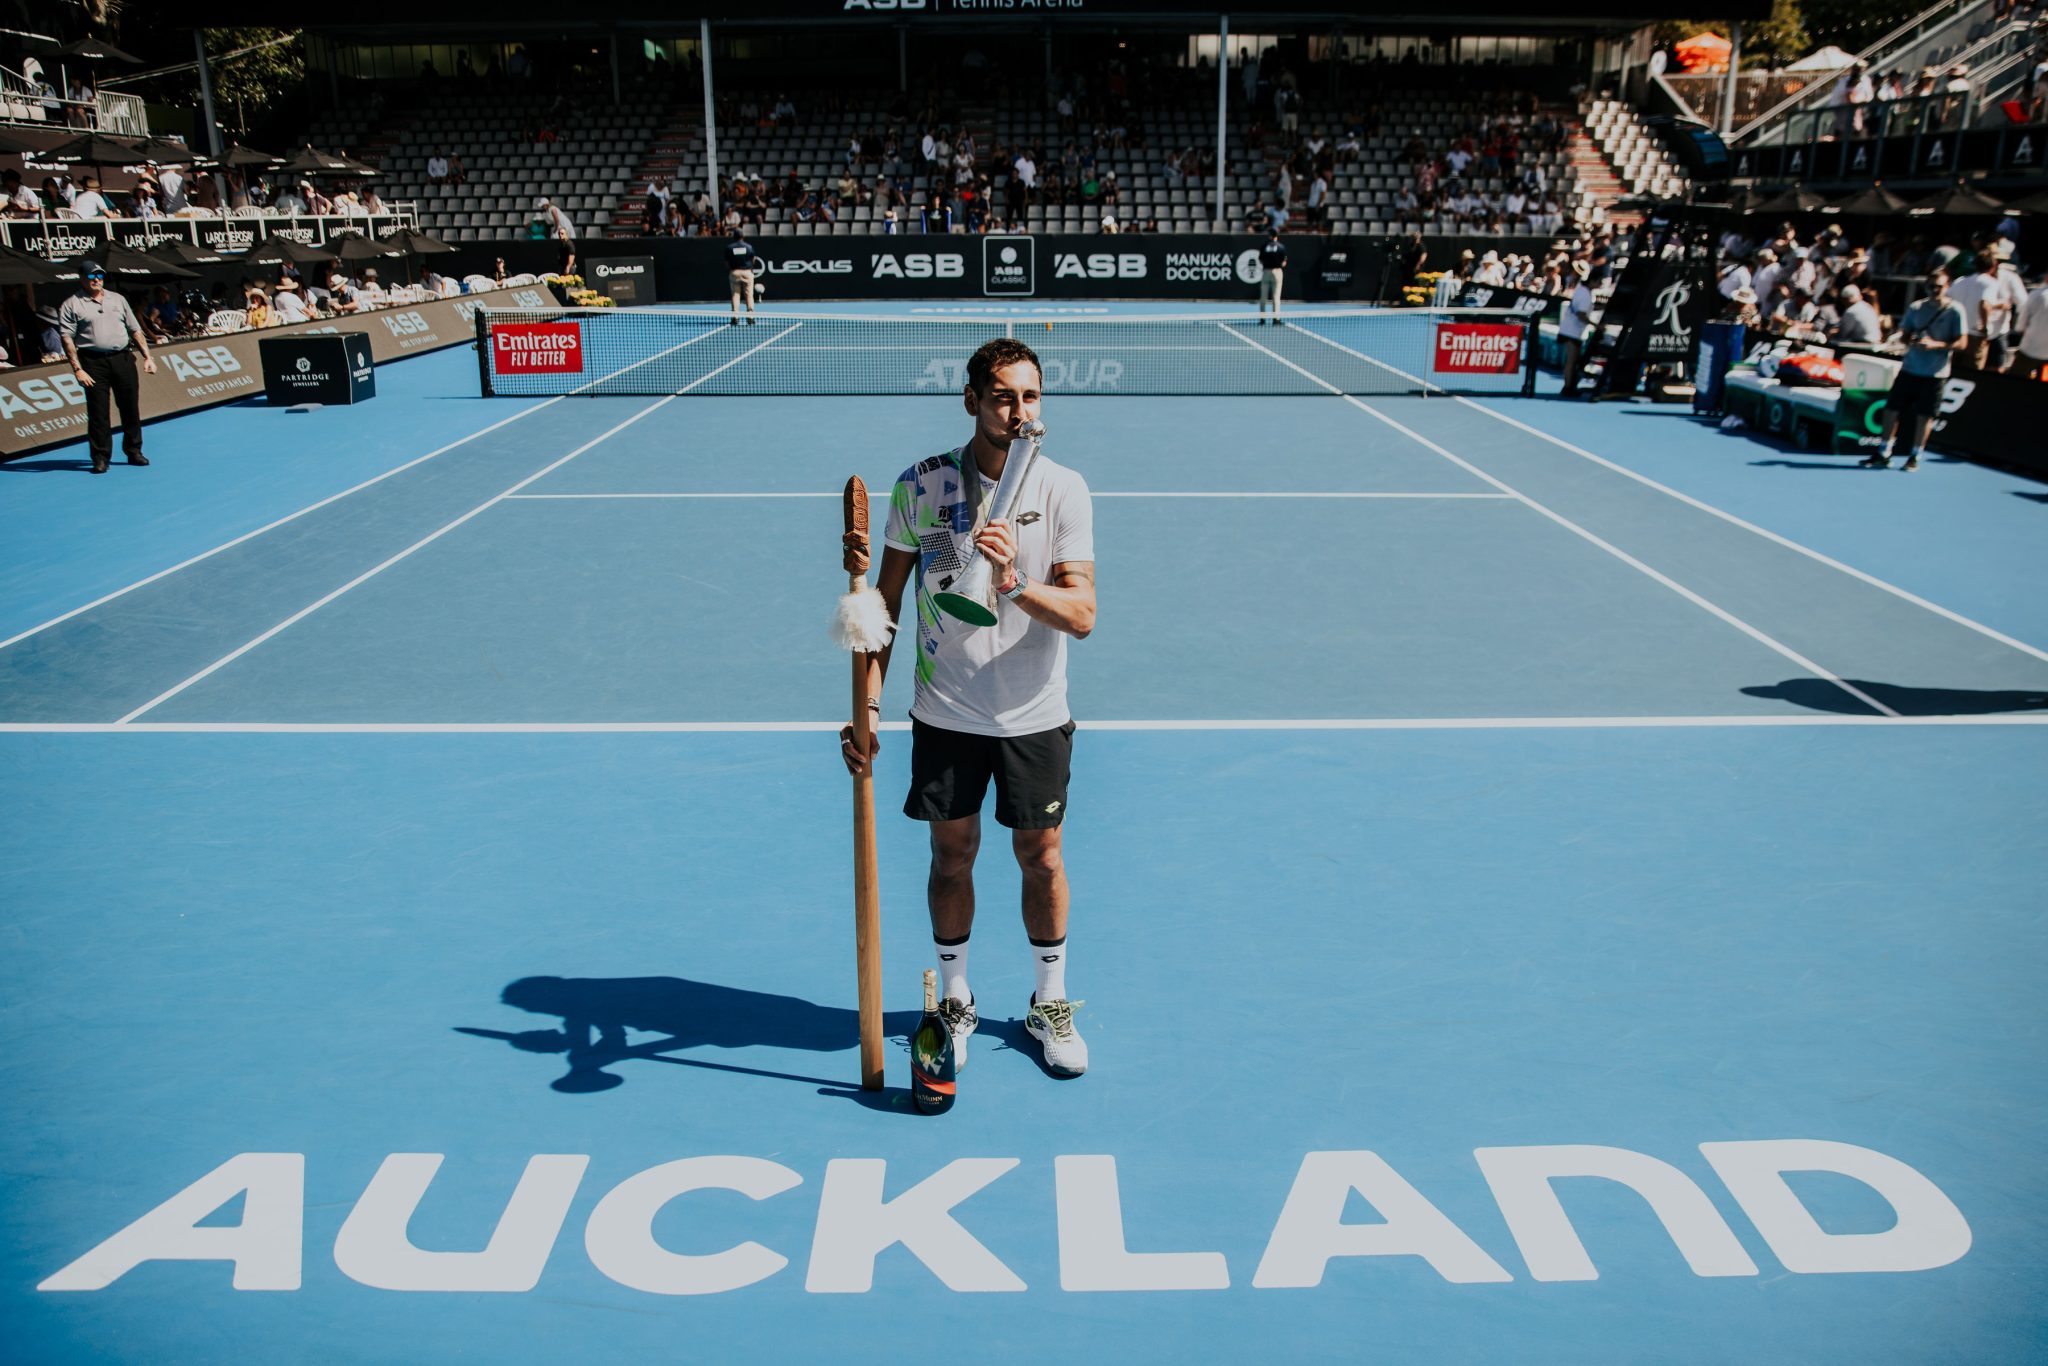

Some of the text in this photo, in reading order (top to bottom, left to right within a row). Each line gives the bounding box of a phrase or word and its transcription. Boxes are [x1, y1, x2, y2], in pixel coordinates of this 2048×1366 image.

[767, 259, 853, 274] LEXUS
[871, 253, 965, 279] ASB
[1053, 253, 1148, 279] ASB
[1166, 253, 1232, 267] MANUKA
[609, 265, 645, 275] LEXUS
[994, 266, 1024, 276] ASB
[1166, 267, 1231, 281] DOCTOR
[990, 275, 1027, 284] CLASSIC
[381, 311, 430, 337] ASB
[497, 331, 577, 351] Emirates
[1440, 331, 1518, 352] Emirates
[161, 345, 242, 382] ASB
[511, 350, 566, 367] FLY BETTER
[1449, 350, 1506, 367] FLY BETTER
[281, 373, 330, 382] PARTRIDGE
[1042, 357, 1124, 389] OUR
[0, 373, 88, 420] ASB
[187, 383, 205, 398] ONE
[14, 424, 42, 438] ONE
[36, 1138, 1974, 1296] AUCKLAND
